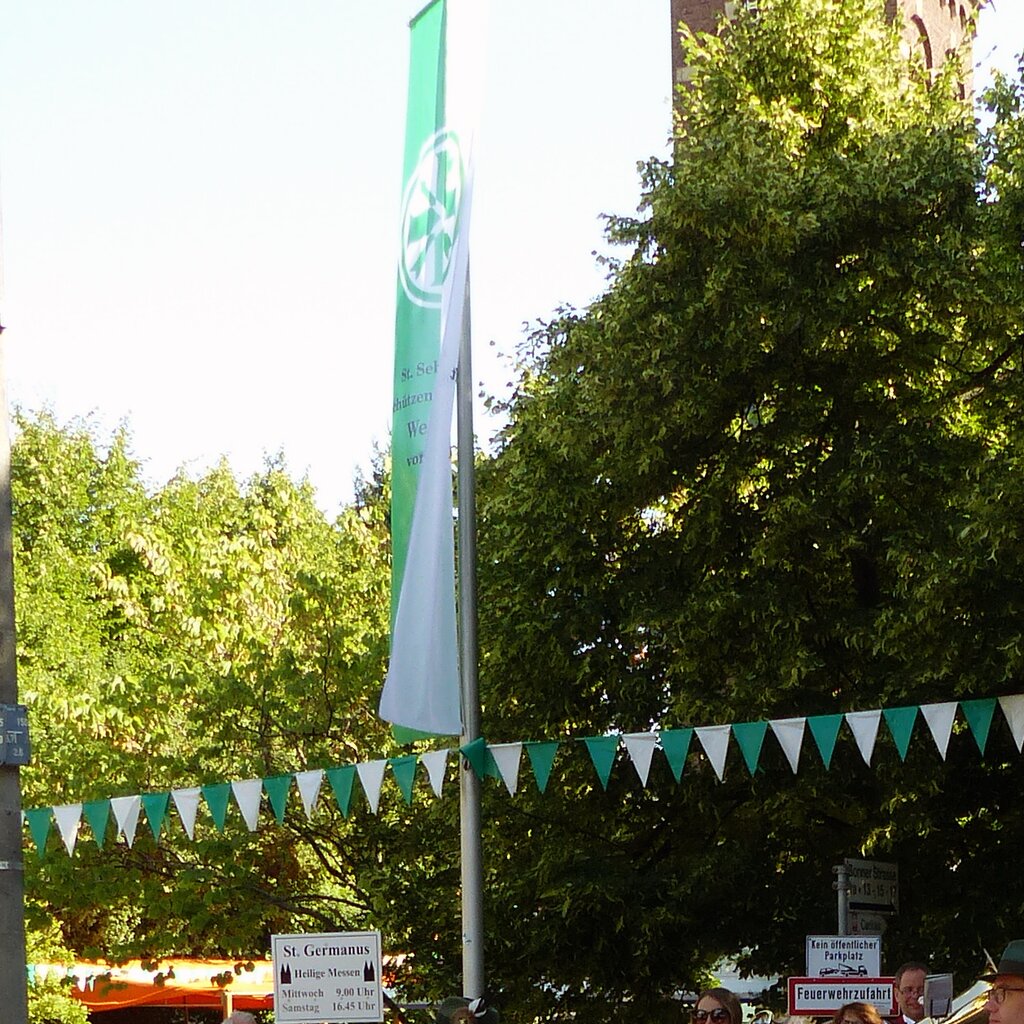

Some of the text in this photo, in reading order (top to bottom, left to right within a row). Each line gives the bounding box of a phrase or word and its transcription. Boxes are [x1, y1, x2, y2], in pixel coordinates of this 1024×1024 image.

[811, 939, 878, 950] Kein öffentlicher
[283, 944, 370, 958] St. Germanus
[824, 951, 864, 962] Parkplatz
[294, 968, 360, 979] Heilige Messen
[282, 988, 375, 999] Mittwoch 9.00 Uhr
[797, 987, 892, 1000] Feuerwehrzufahrt
[282, 1002, 376, 1014] Samstag 16.45 Uhr
